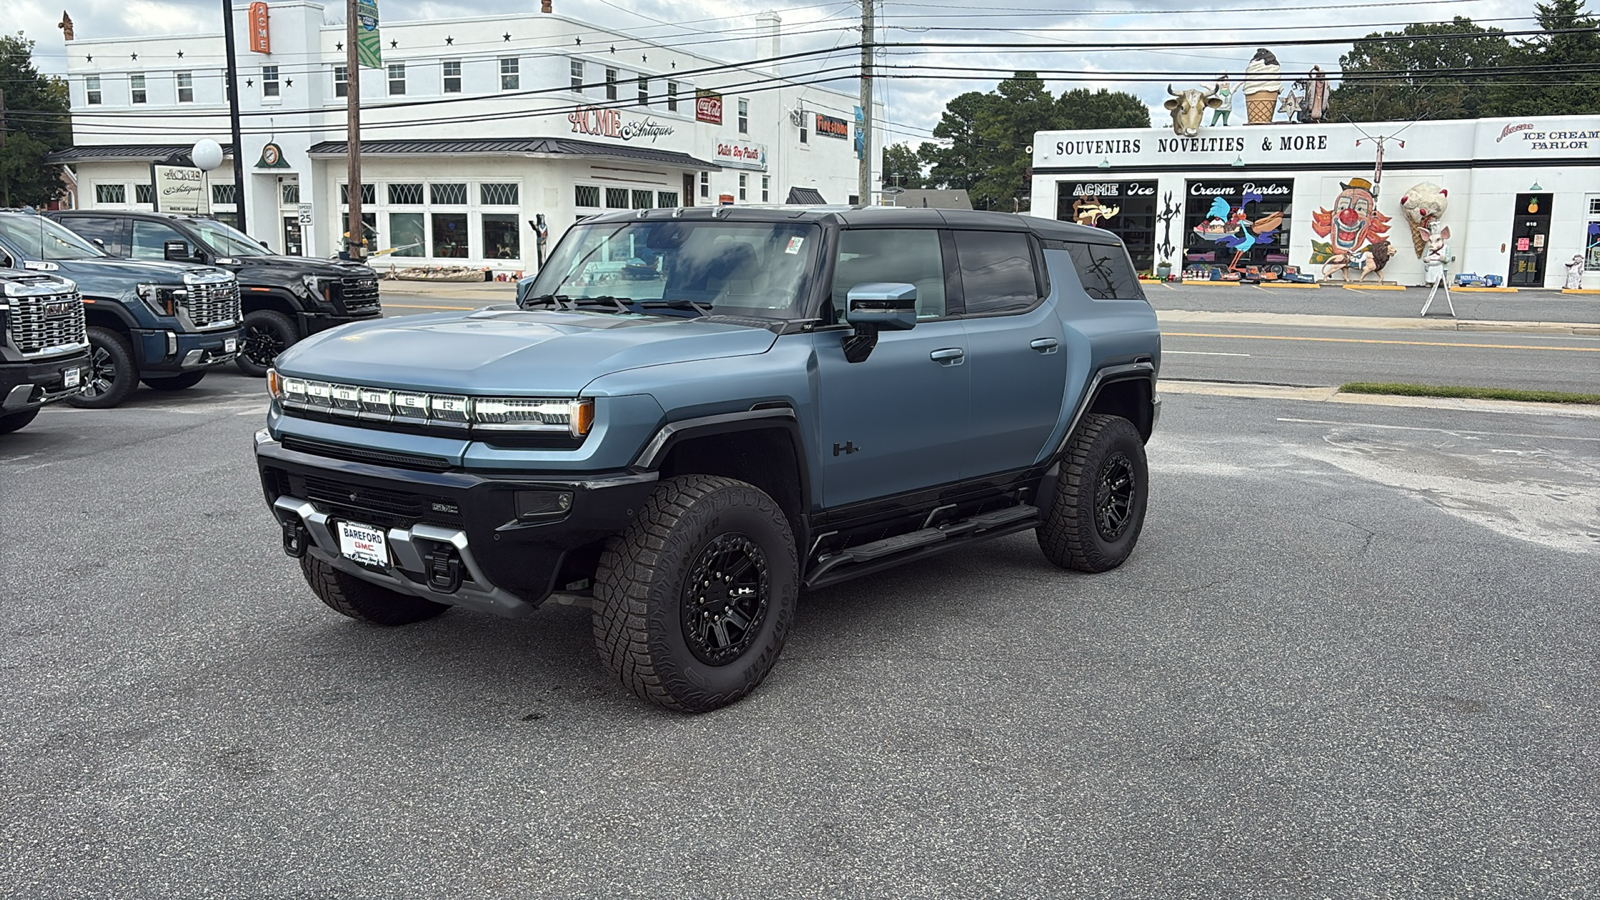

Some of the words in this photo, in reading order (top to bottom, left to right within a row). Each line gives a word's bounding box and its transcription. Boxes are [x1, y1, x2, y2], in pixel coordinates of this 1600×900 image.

[258, 6, 268, 49] ACME
[568, 105, 622, 139] ACME
[1523, 132, 1546, 141] ICE
[1549, 130, 1600, 140] CREAM
[1056, 139, 1141, 155] SOUVENIRS
[1157, 137, 1245, 153] NOVELTIES
[1261, 136, 1273, 151] &
[1279, 135, 1328, 151] MORE
[1531, 141, 1588, 150] PARLOR
[1073, 183, 1119, 196] ACME
[1127, 183, 1155, 196] Ice
[1190, 183, 1236, 196] Cream
[1242, 183, 1291, 196] Parlor
[300, 214, 312, 223] 25
[292, 385, 454, 410] HUMMER
[343, 528, 383, 544] BAREFORD
[354, 541, 375, 552] GMC
